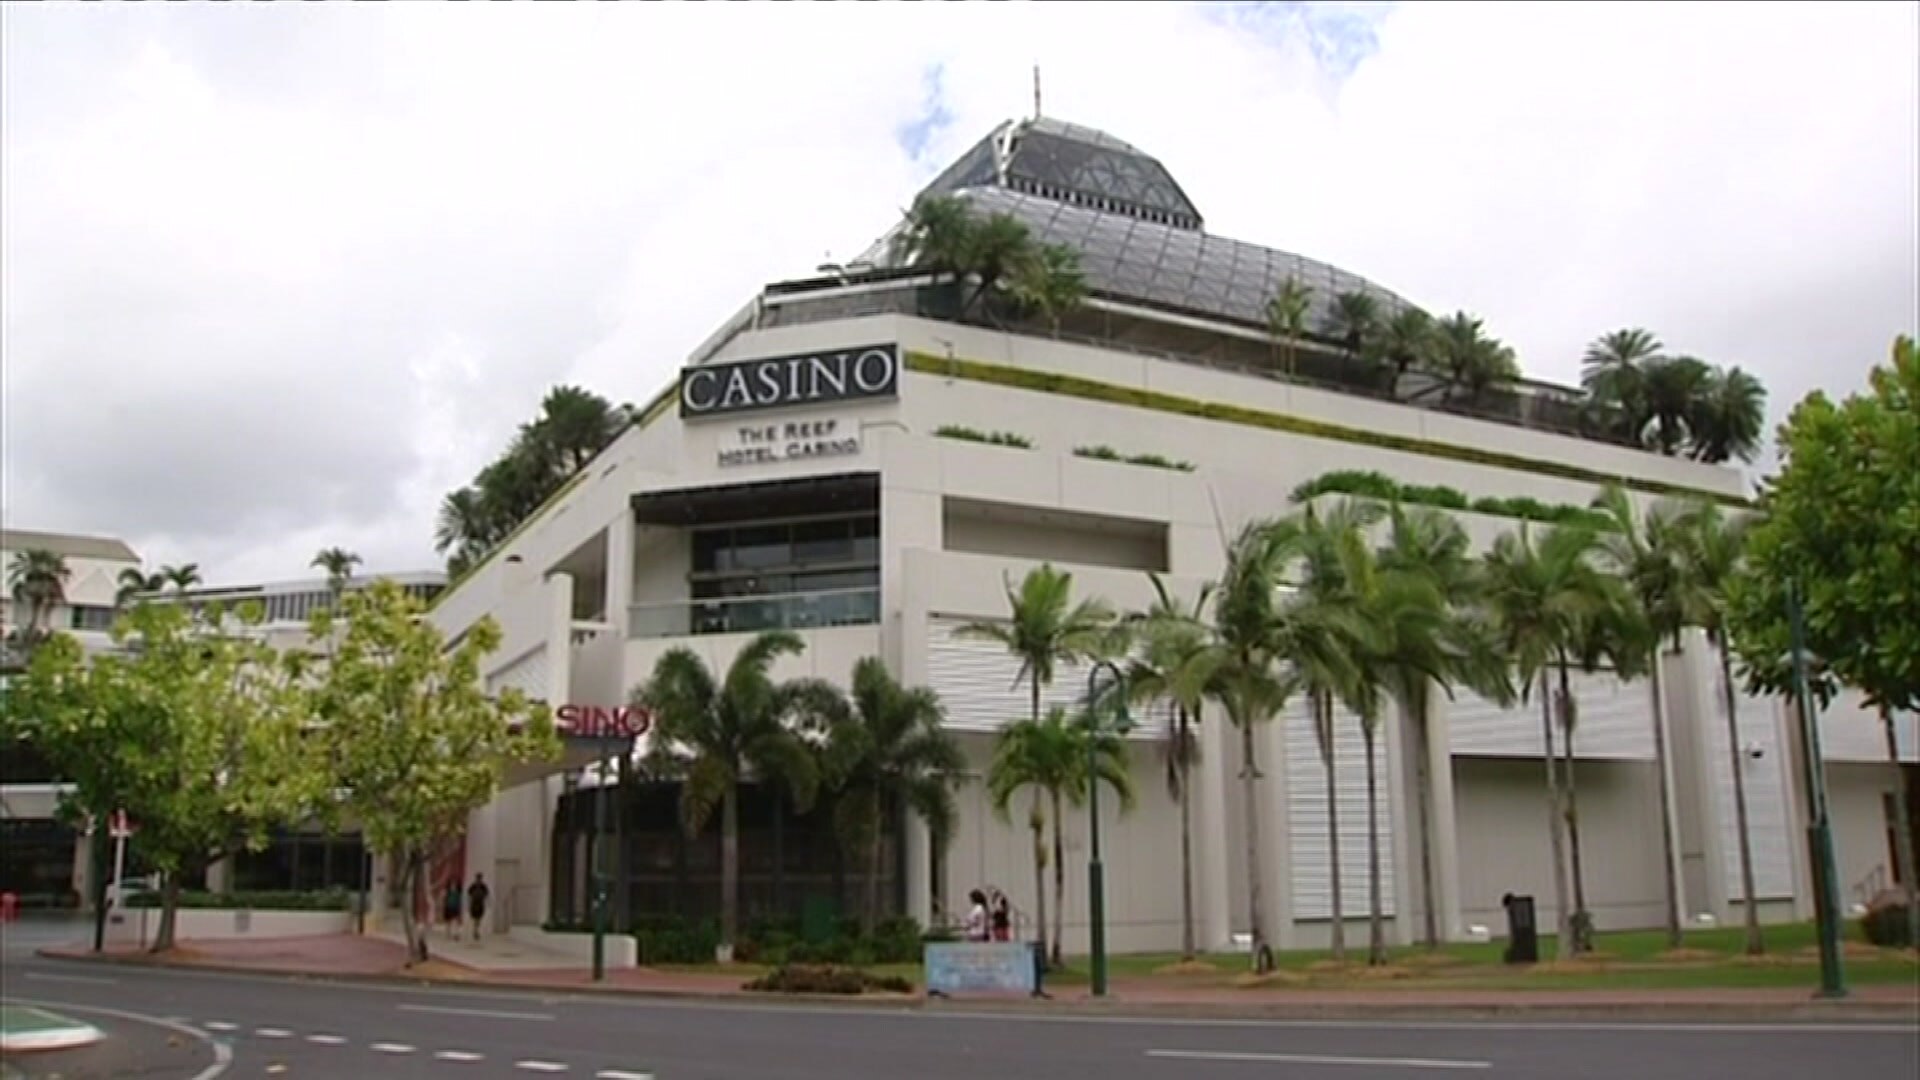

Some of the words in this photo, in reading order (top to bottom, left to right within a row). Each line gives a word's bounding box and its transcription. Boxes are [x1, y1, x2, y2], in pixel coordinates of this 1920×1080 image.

[682, 350, 892, 411] CASINO
[738, 427, 776, 444] THE
[784, 420, 836, 438] REEF
[718, 448, 779, 467] HOTEL
[786, 438, 858, 459] CASINO
[556, 704, 649, 736] SINO
